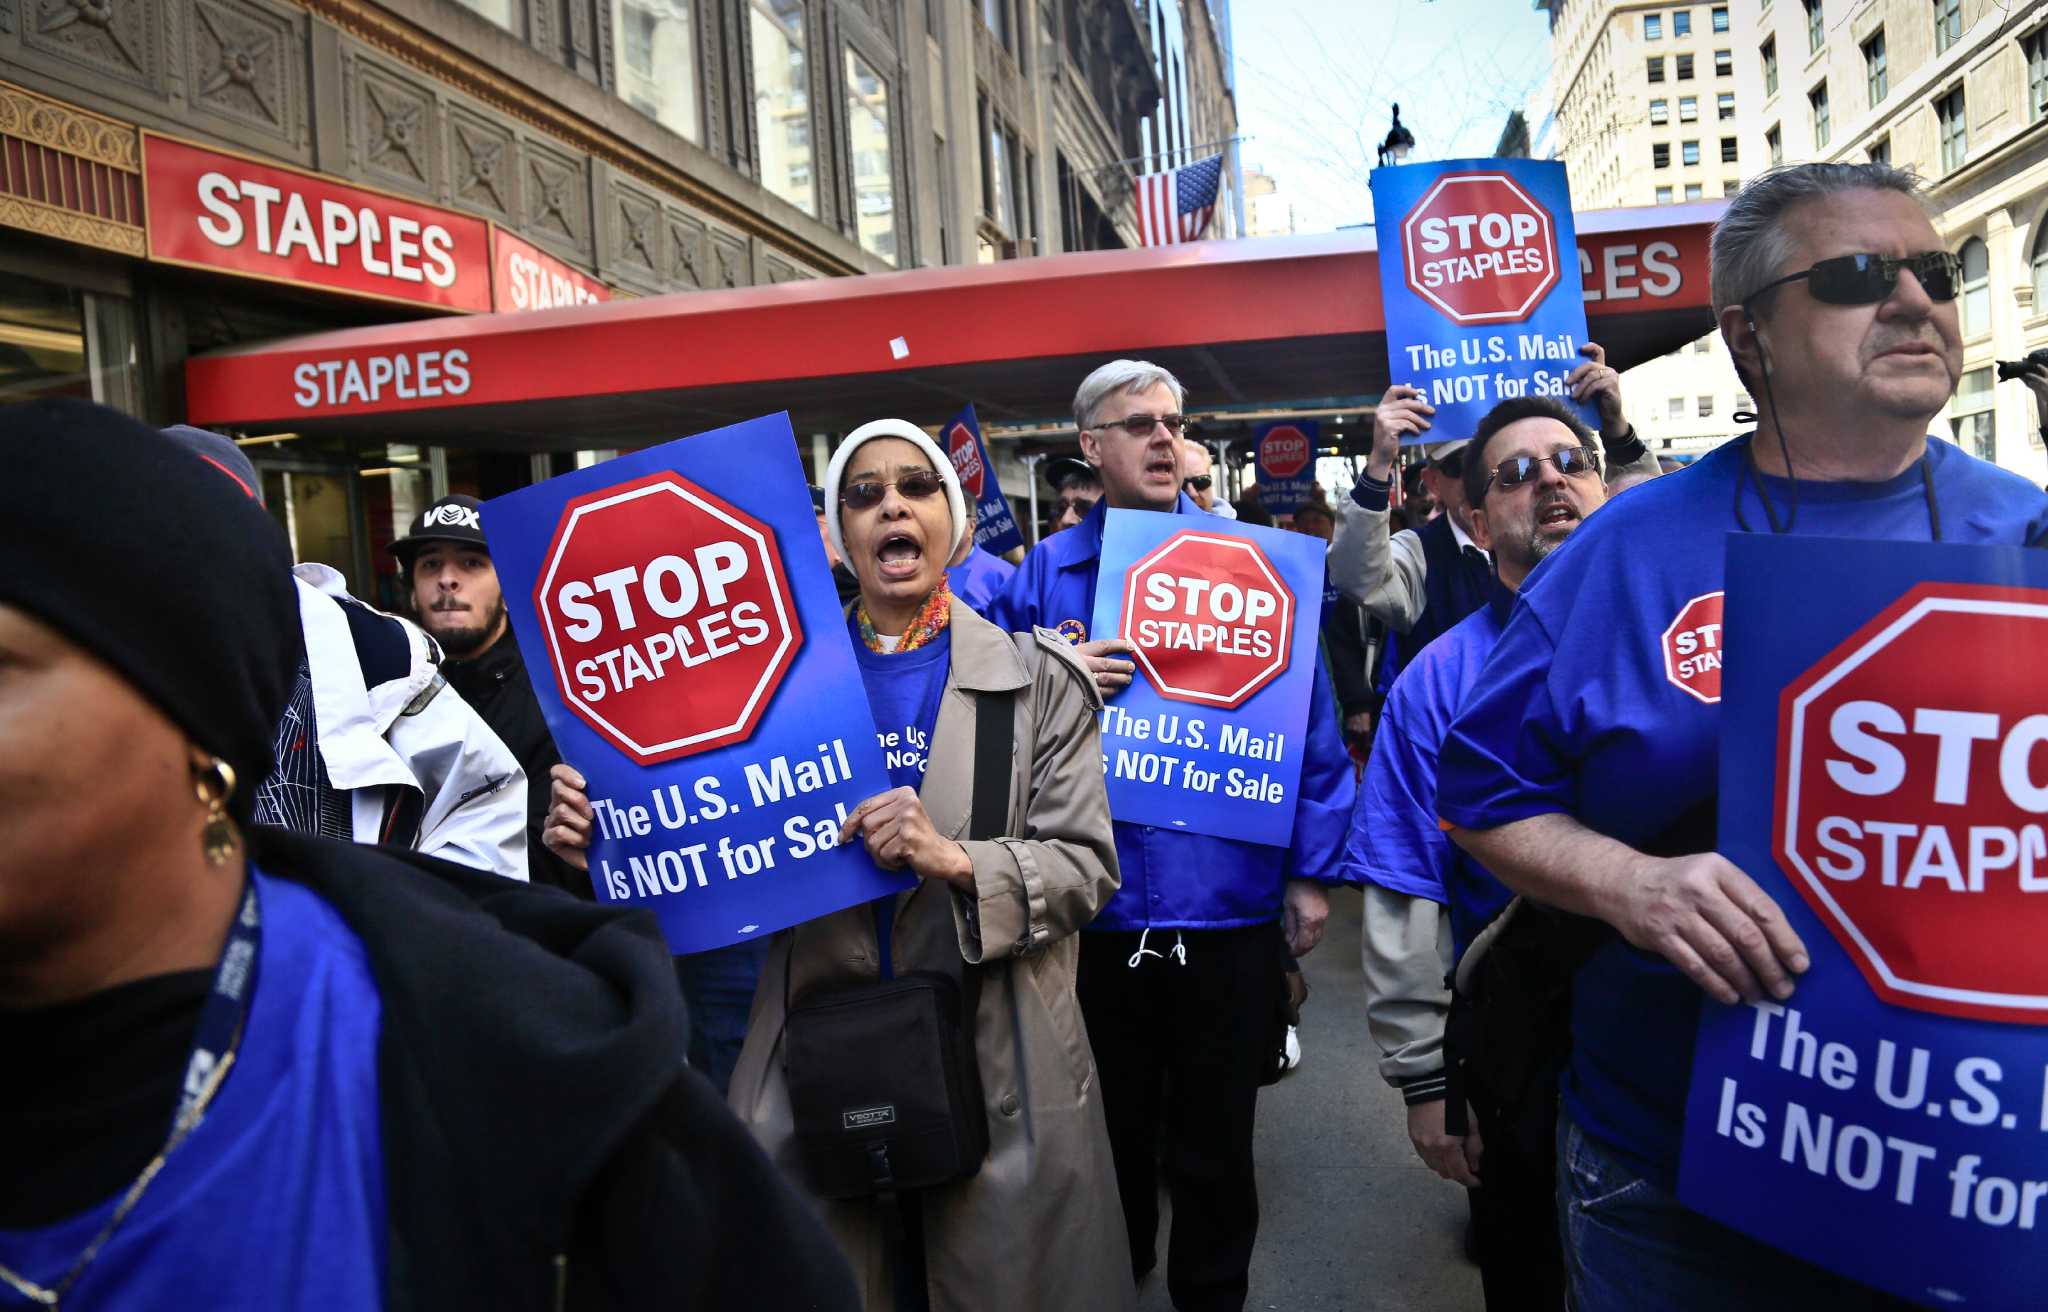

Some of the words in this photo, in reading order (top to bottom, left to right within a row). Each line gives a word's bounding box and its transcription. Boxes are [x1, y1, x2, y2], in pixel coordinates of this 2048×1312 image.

[197, 172, 456, 287] STAPLES
[1420, 213, 1538, 254] STOP
[510, 252, 599, 310] STAP
[1423, 247, 1543, 288] STAPLES
[294, 349, 471, 408] STAPLES
[1406, 344, 1456, 371] The
[1460, 337, 1513, 366] U.S.
[1520, 335, 1576, 361] Mail
[1405, 383, 1427, 406] s
[1433, 374, 1489, 405] NOT
[1495, 372, 1529, 397] for
[1534, 370, 1572, 397] Sal
[558, 539, 749, 644] STOP
[1144, 573, 1277, 627] STOP
[575, 600, 770, 702] STAPLES
[1138, 620, 1273, 658] STAPLES
[1678, 650, 1722, 679] STA
[1101, 705, 1150, 740] The
[1157, 714, 1209, 750] U.S.
[1219, 725, 1284, 762] Mail
[590, 799, 652, 840] The
[651, 770, 739, 830] U.S.
[743, 739, 852, 807] Mail
[1115, 749, 1181, 785] NOT
[1183, 762, 1220, 793] for
[1225, 769, 1284, 804] Sale
[601, 860, 631, 900] Is
[629, 842, 707, 896] NOT
[718, 832, 775, 881] for
[784, 802, 849, 859] Sal
[1745, 1001, 1858, 1091] The
[1874, 1039, 2017, 1131] U.S.
[1716, 1077, 1767, 1148] Is
[1780, 1105, 1936, 1206] NOT
[1949, 1154, 2048, 1230] for
